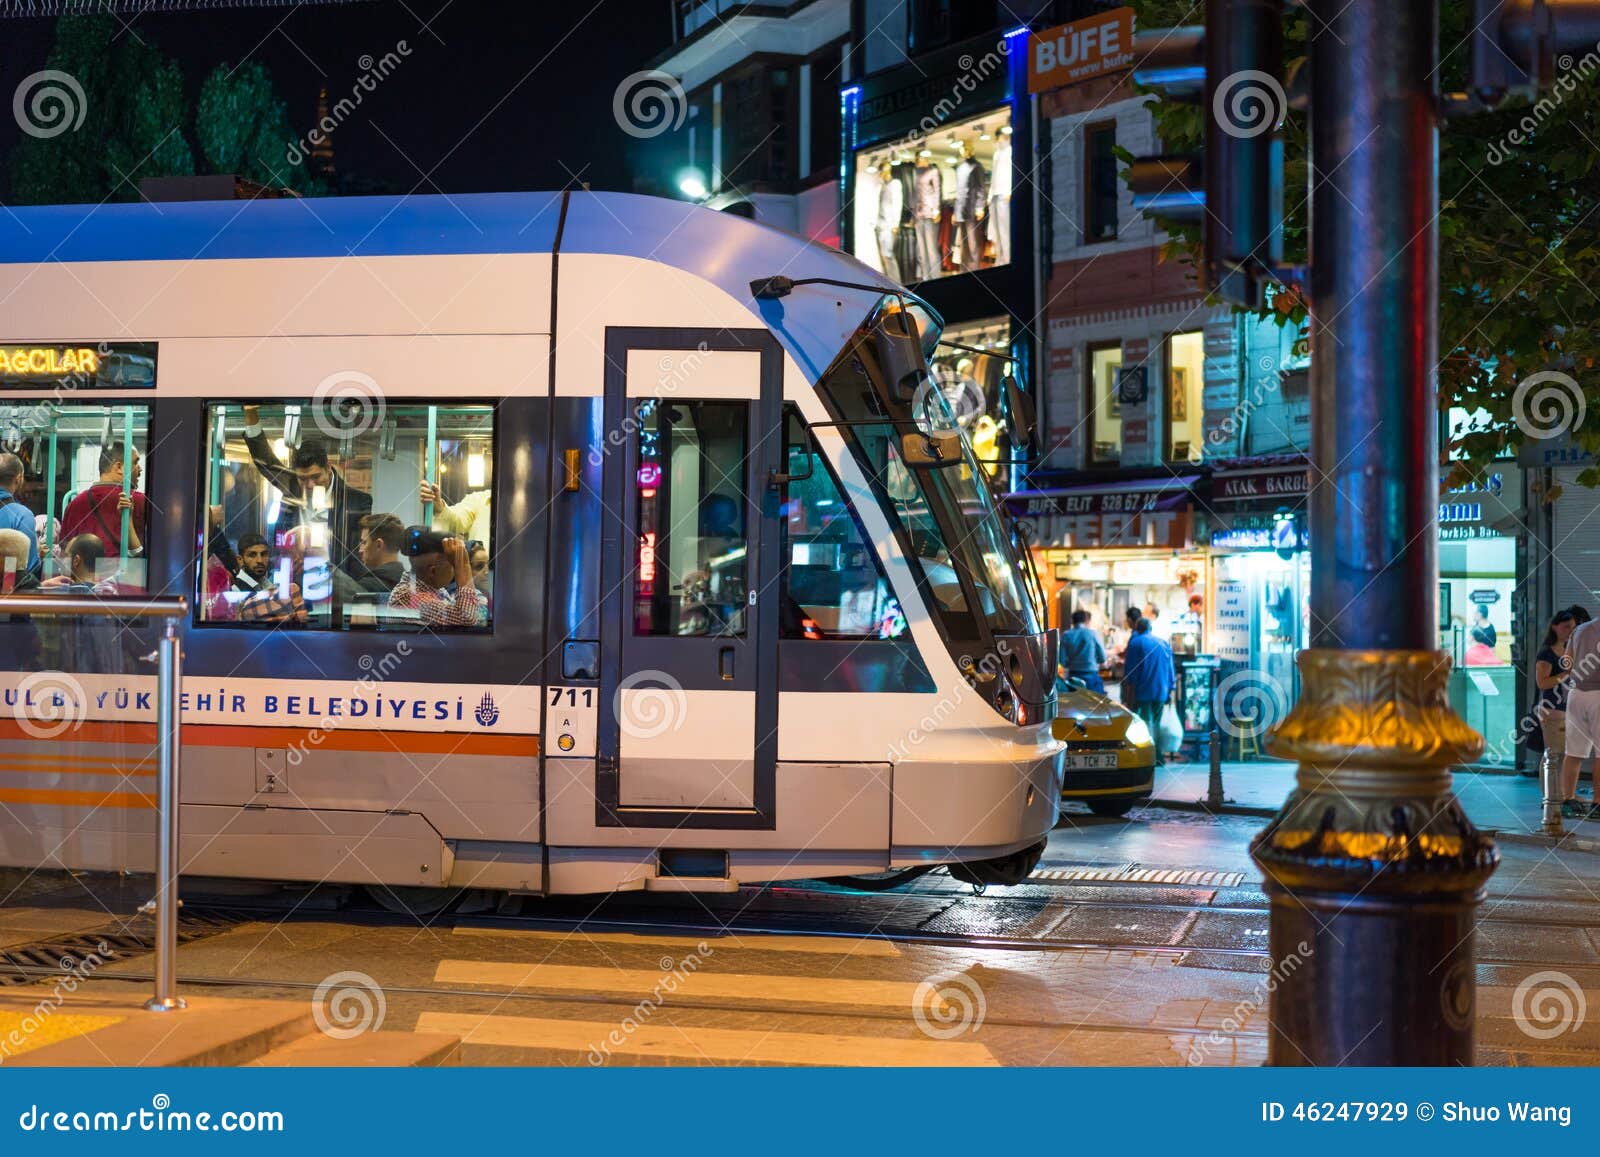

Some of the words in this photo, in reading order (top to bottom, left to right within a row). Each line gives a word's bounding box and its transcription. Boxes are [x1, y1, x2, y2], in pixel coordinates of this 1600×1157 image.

[1036, 20, 1120, 75] BÜFE
[1066, 497, 1093, 512] ELIT
[264, 692, 464, 721] BELEDİYESİ
[549, 687, 593, 708] 711
